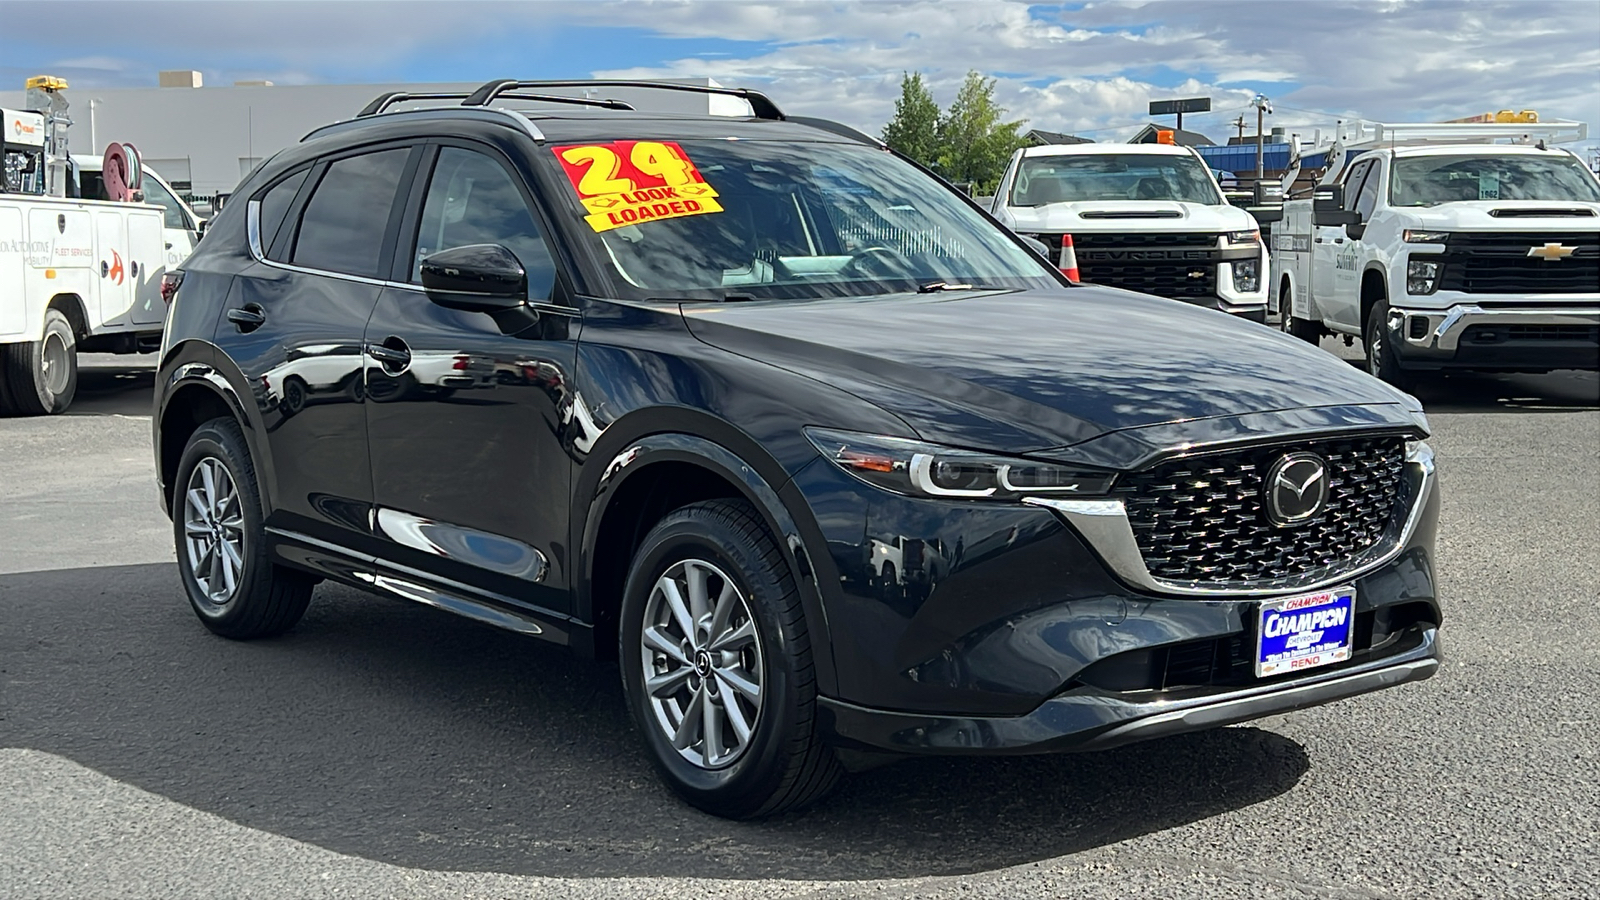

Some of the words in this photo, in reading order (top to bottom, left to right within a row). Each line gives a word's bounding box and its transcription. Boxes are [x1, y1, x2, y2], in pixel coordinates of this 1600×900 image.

[561, 141, 697, 196] 24
[621, 187, 680, 204] LOOK
[607, 200, 702, 225] LOADED
[1286, 593, 1332, 610] CHAMPION
[1264, 607, 1348, 638] CHAMPION
[1288, 633, 1321, 645] CHEVROLET
[1291, 655, 1320, 669] RENO
